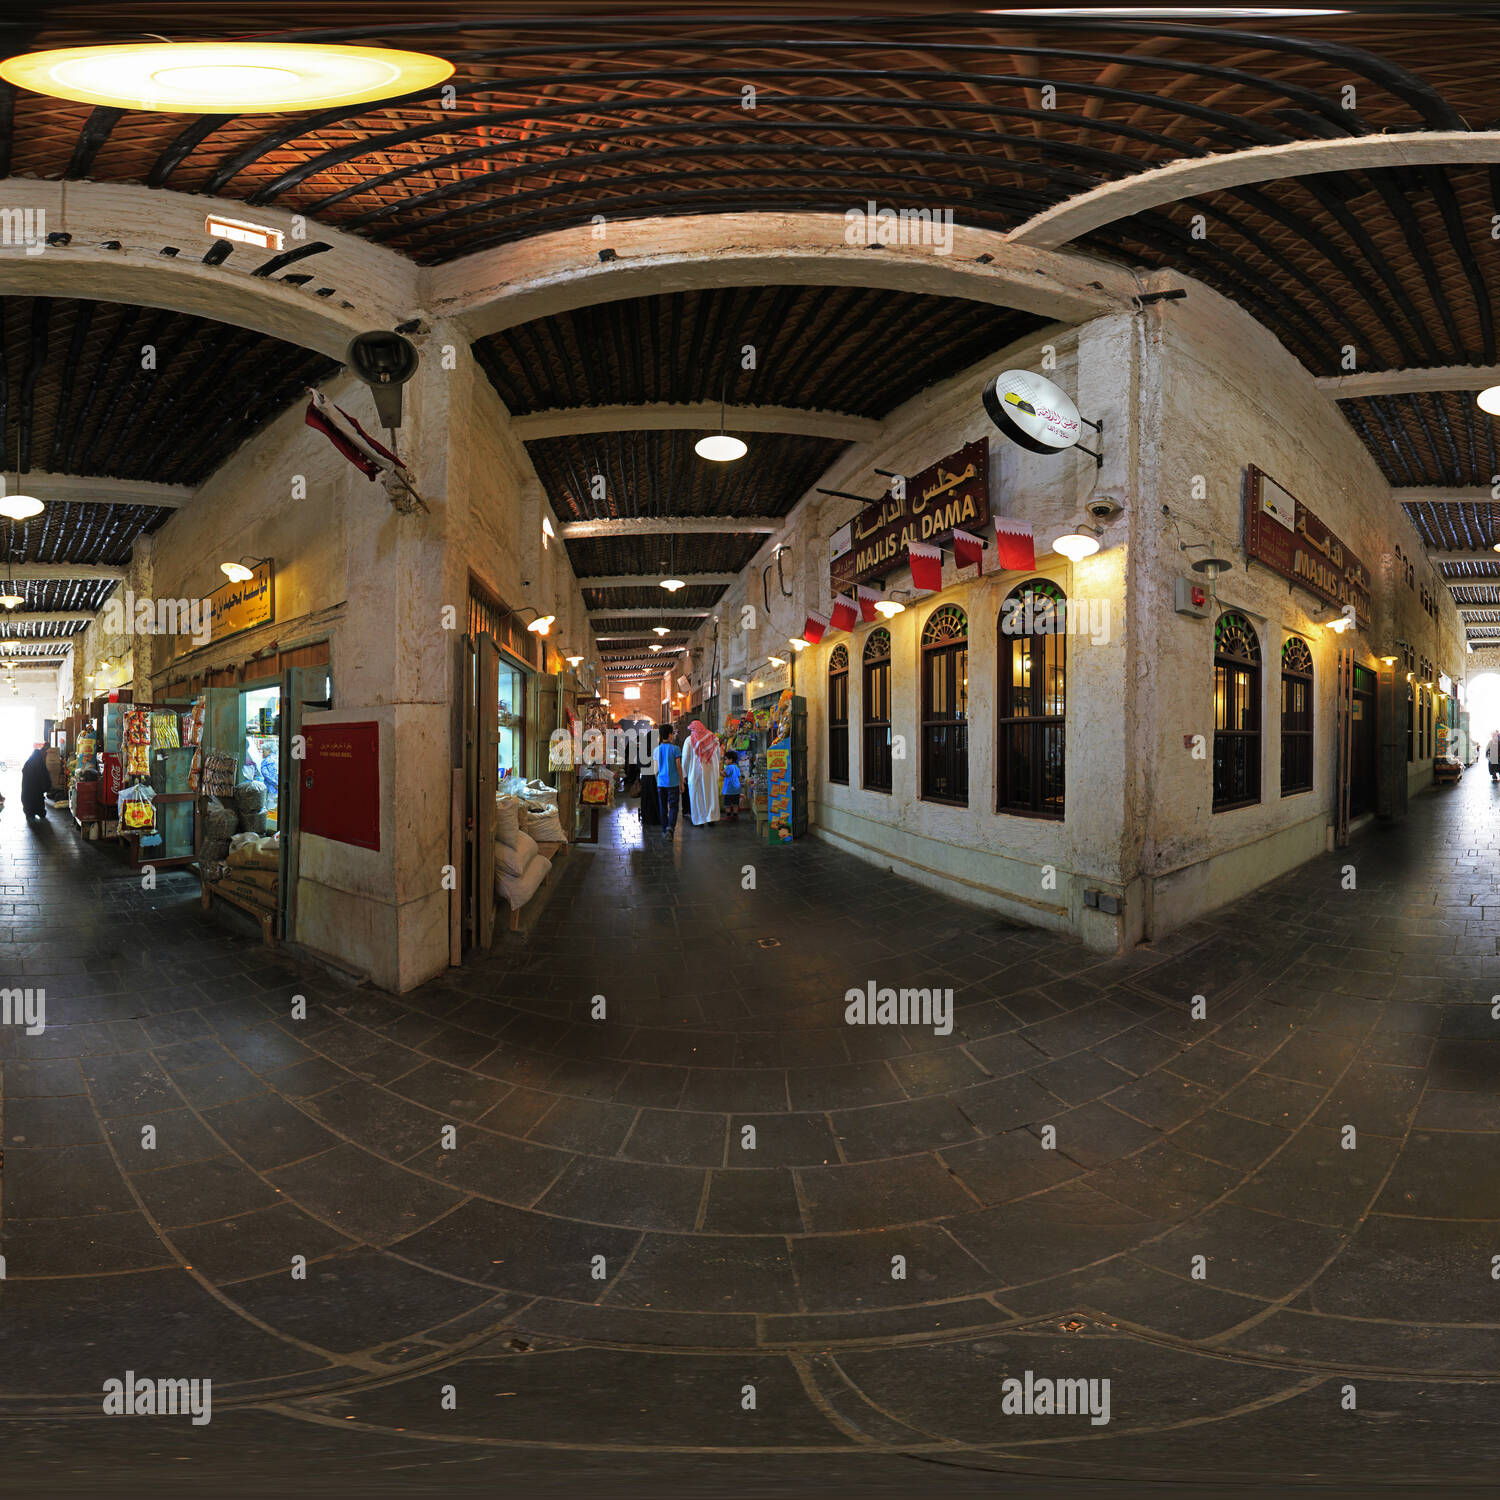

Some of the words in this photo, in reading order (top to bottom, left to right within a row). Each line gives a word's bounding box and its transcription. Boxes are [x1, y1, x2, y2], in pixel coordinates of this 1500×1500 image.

[912, 463, 977, 514] مجلس
[855, 494, 905, 541] الدامة
[856, 533, 897, 574] MAJLIS
[900, 522, 918, 552] AL
[921, 494, 976, 541] DAMA
[1294, 549, 1337, 597] MAJLIS
[1338, 583, 1350, 605] AL
